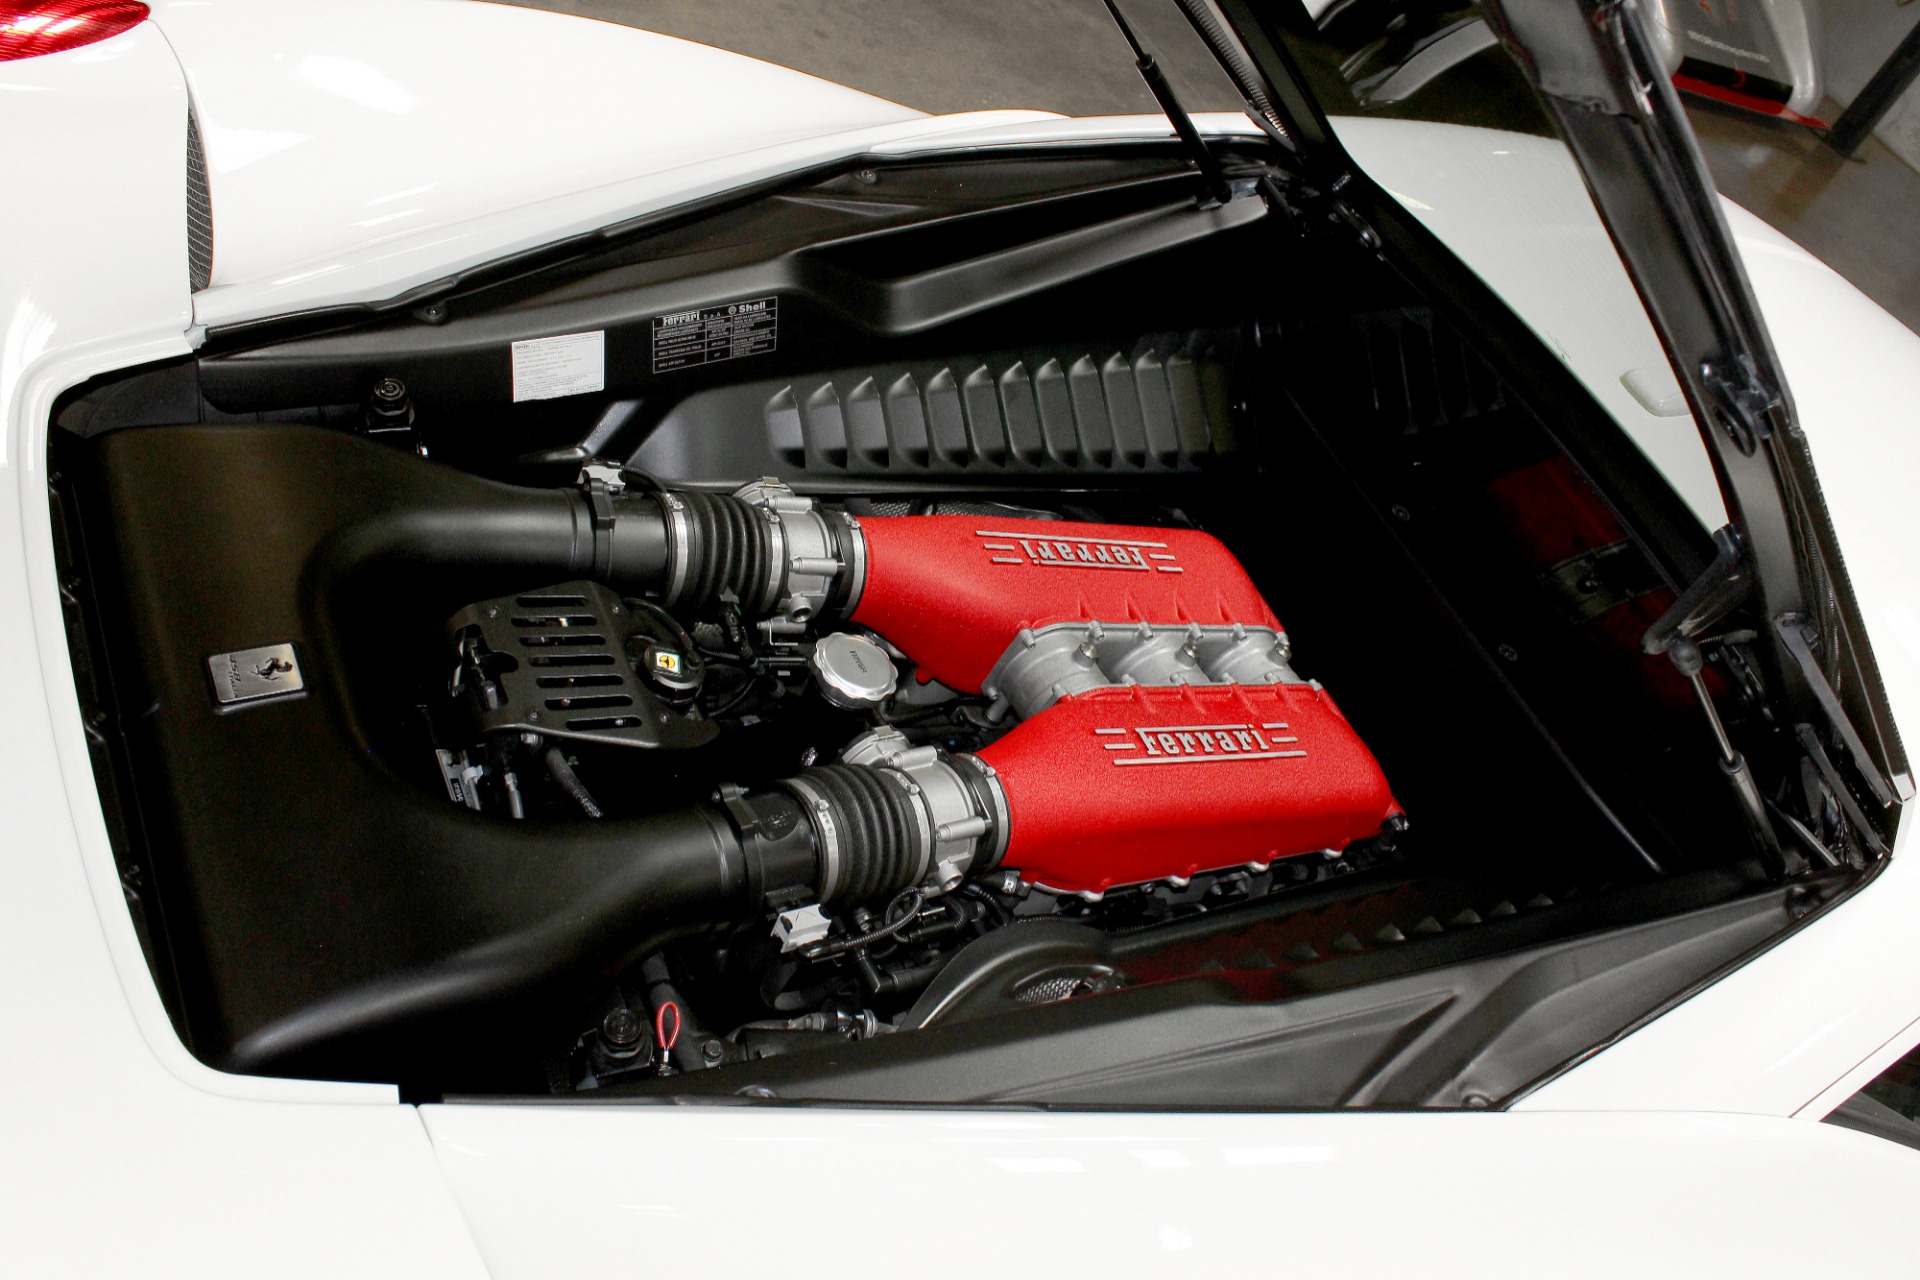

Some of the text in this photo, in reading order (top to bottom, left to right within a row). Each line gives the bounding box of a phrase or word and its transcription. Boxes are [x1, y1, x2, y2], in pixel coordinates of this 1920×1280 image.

[662, 311, 700, 327] Ferrari
[738, 301, 766, 314] Shell
[1019, 540, 1151, 571] Ferrari
[1134, 723, 1270, 756] Ferrari
